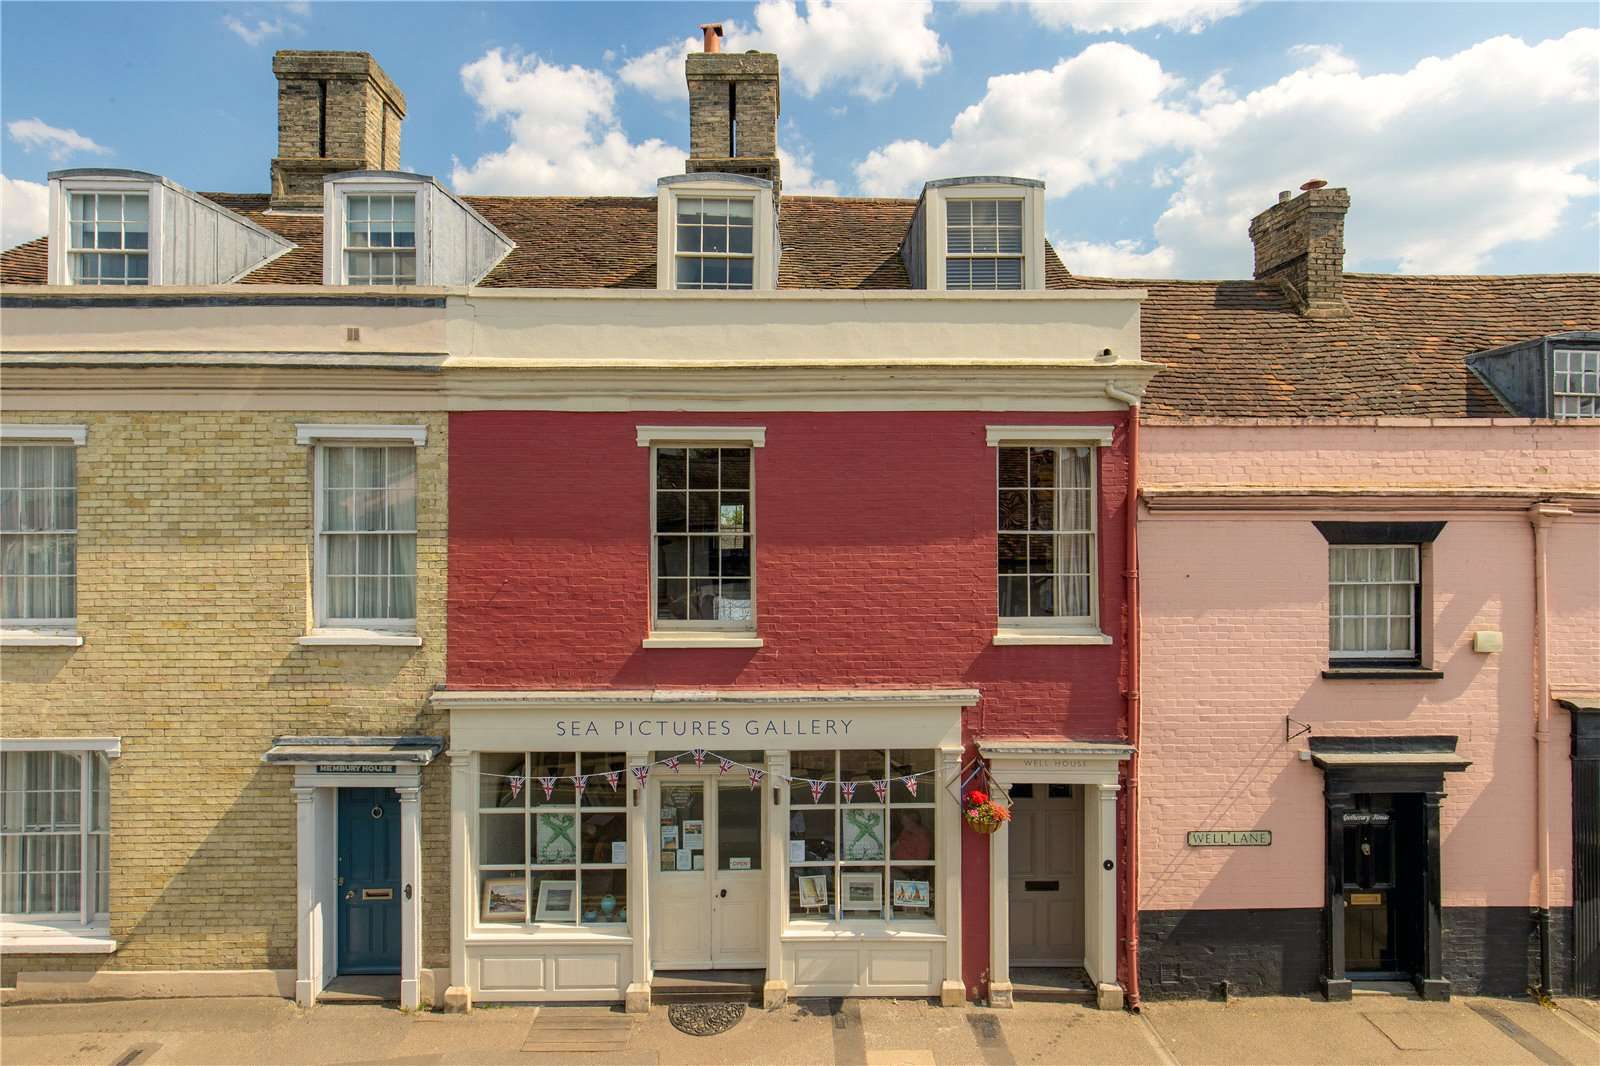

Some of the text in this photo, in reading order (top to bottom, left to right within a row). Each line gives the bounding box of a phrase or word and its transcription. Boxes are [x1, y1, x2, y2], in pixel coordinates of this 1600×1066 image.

[556, 719, 853, 736] SEA PICTURES GALLERY
[361, 764, 393, 773] HOUSE
[1023, 759, 1088, 768] WELL HOUSE
[1192, 832, 1267, 844] WELL LANE
